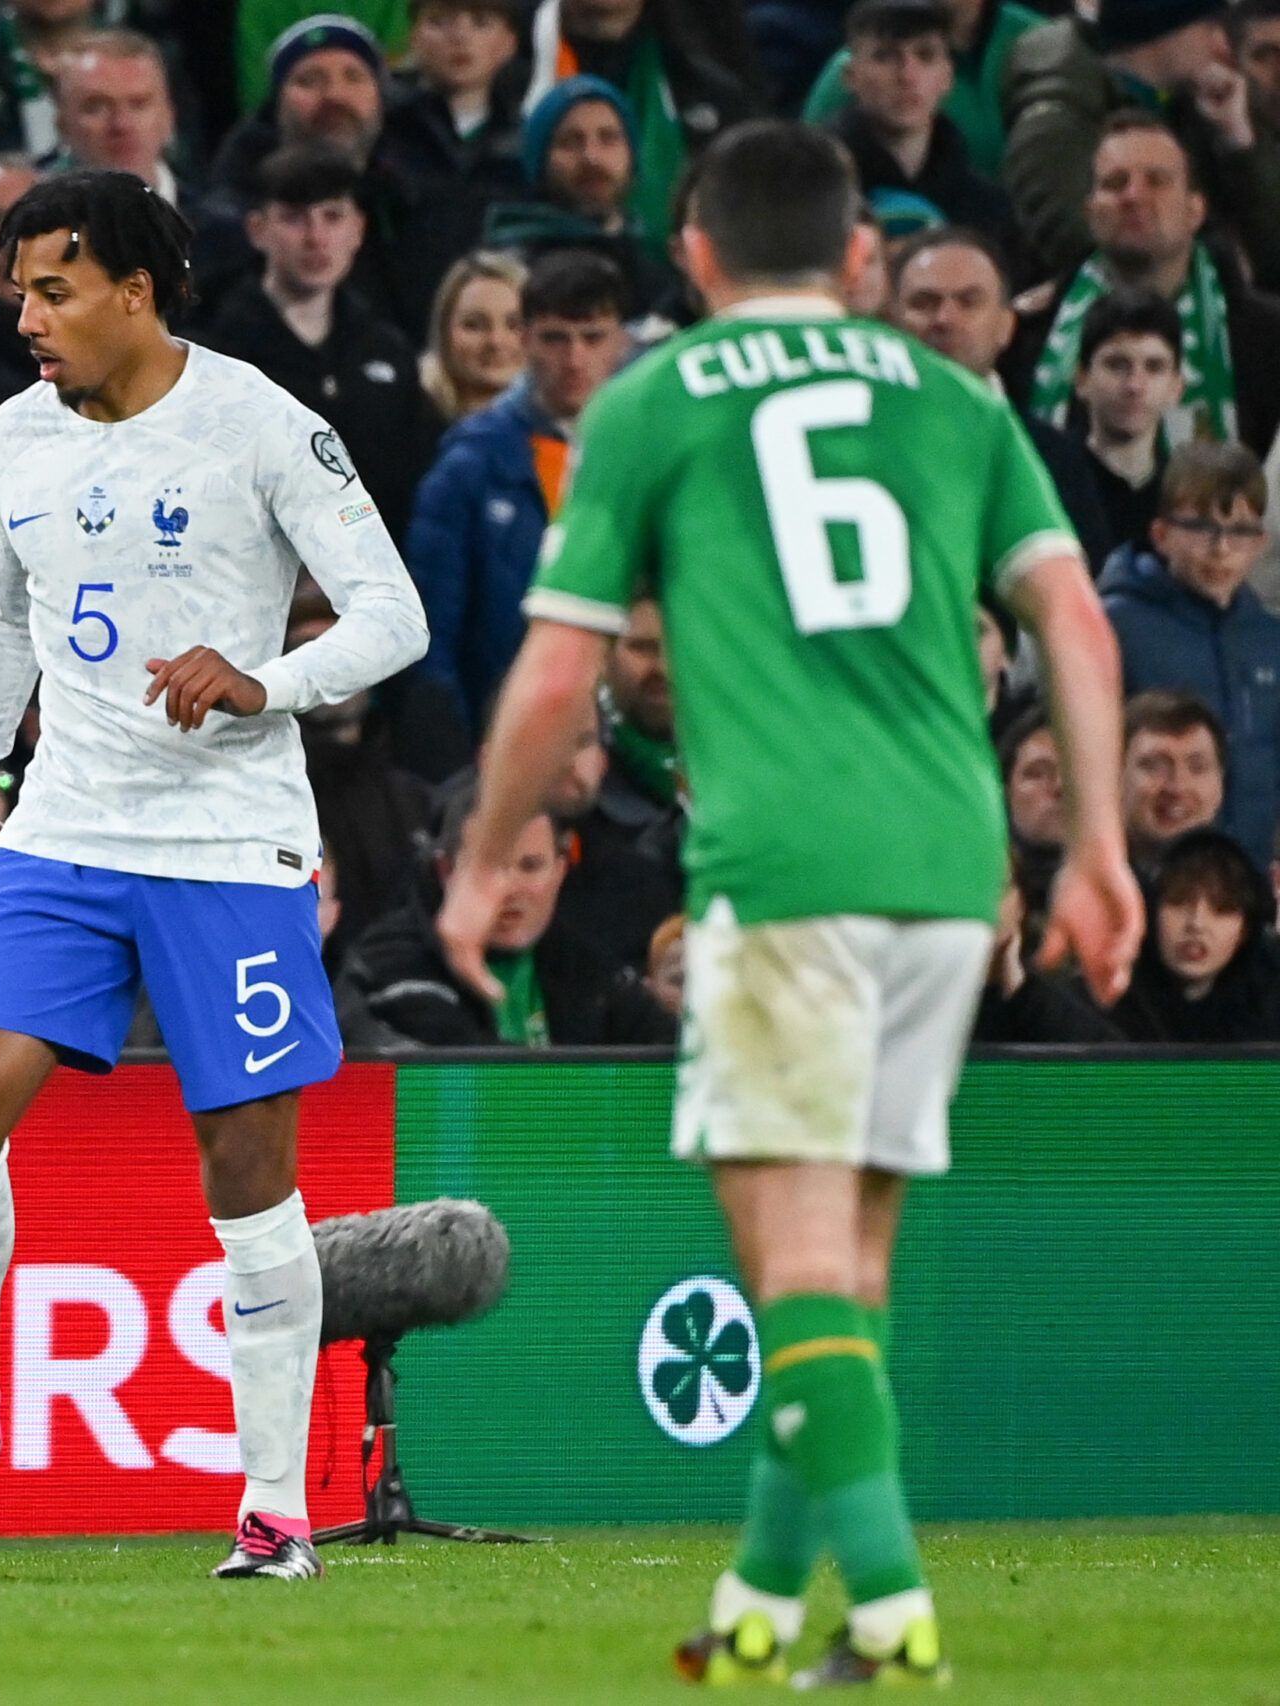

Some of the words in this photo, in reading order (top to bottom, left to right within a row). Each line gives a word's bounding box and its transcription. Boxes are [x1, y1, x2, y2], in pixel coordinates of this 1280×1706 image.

[677, 328, 920, 399] CULLEN
[751, 380, 911, 635] 6
[67, 582, 119, 663] 5
[234, 950, 291, 1037] 5
